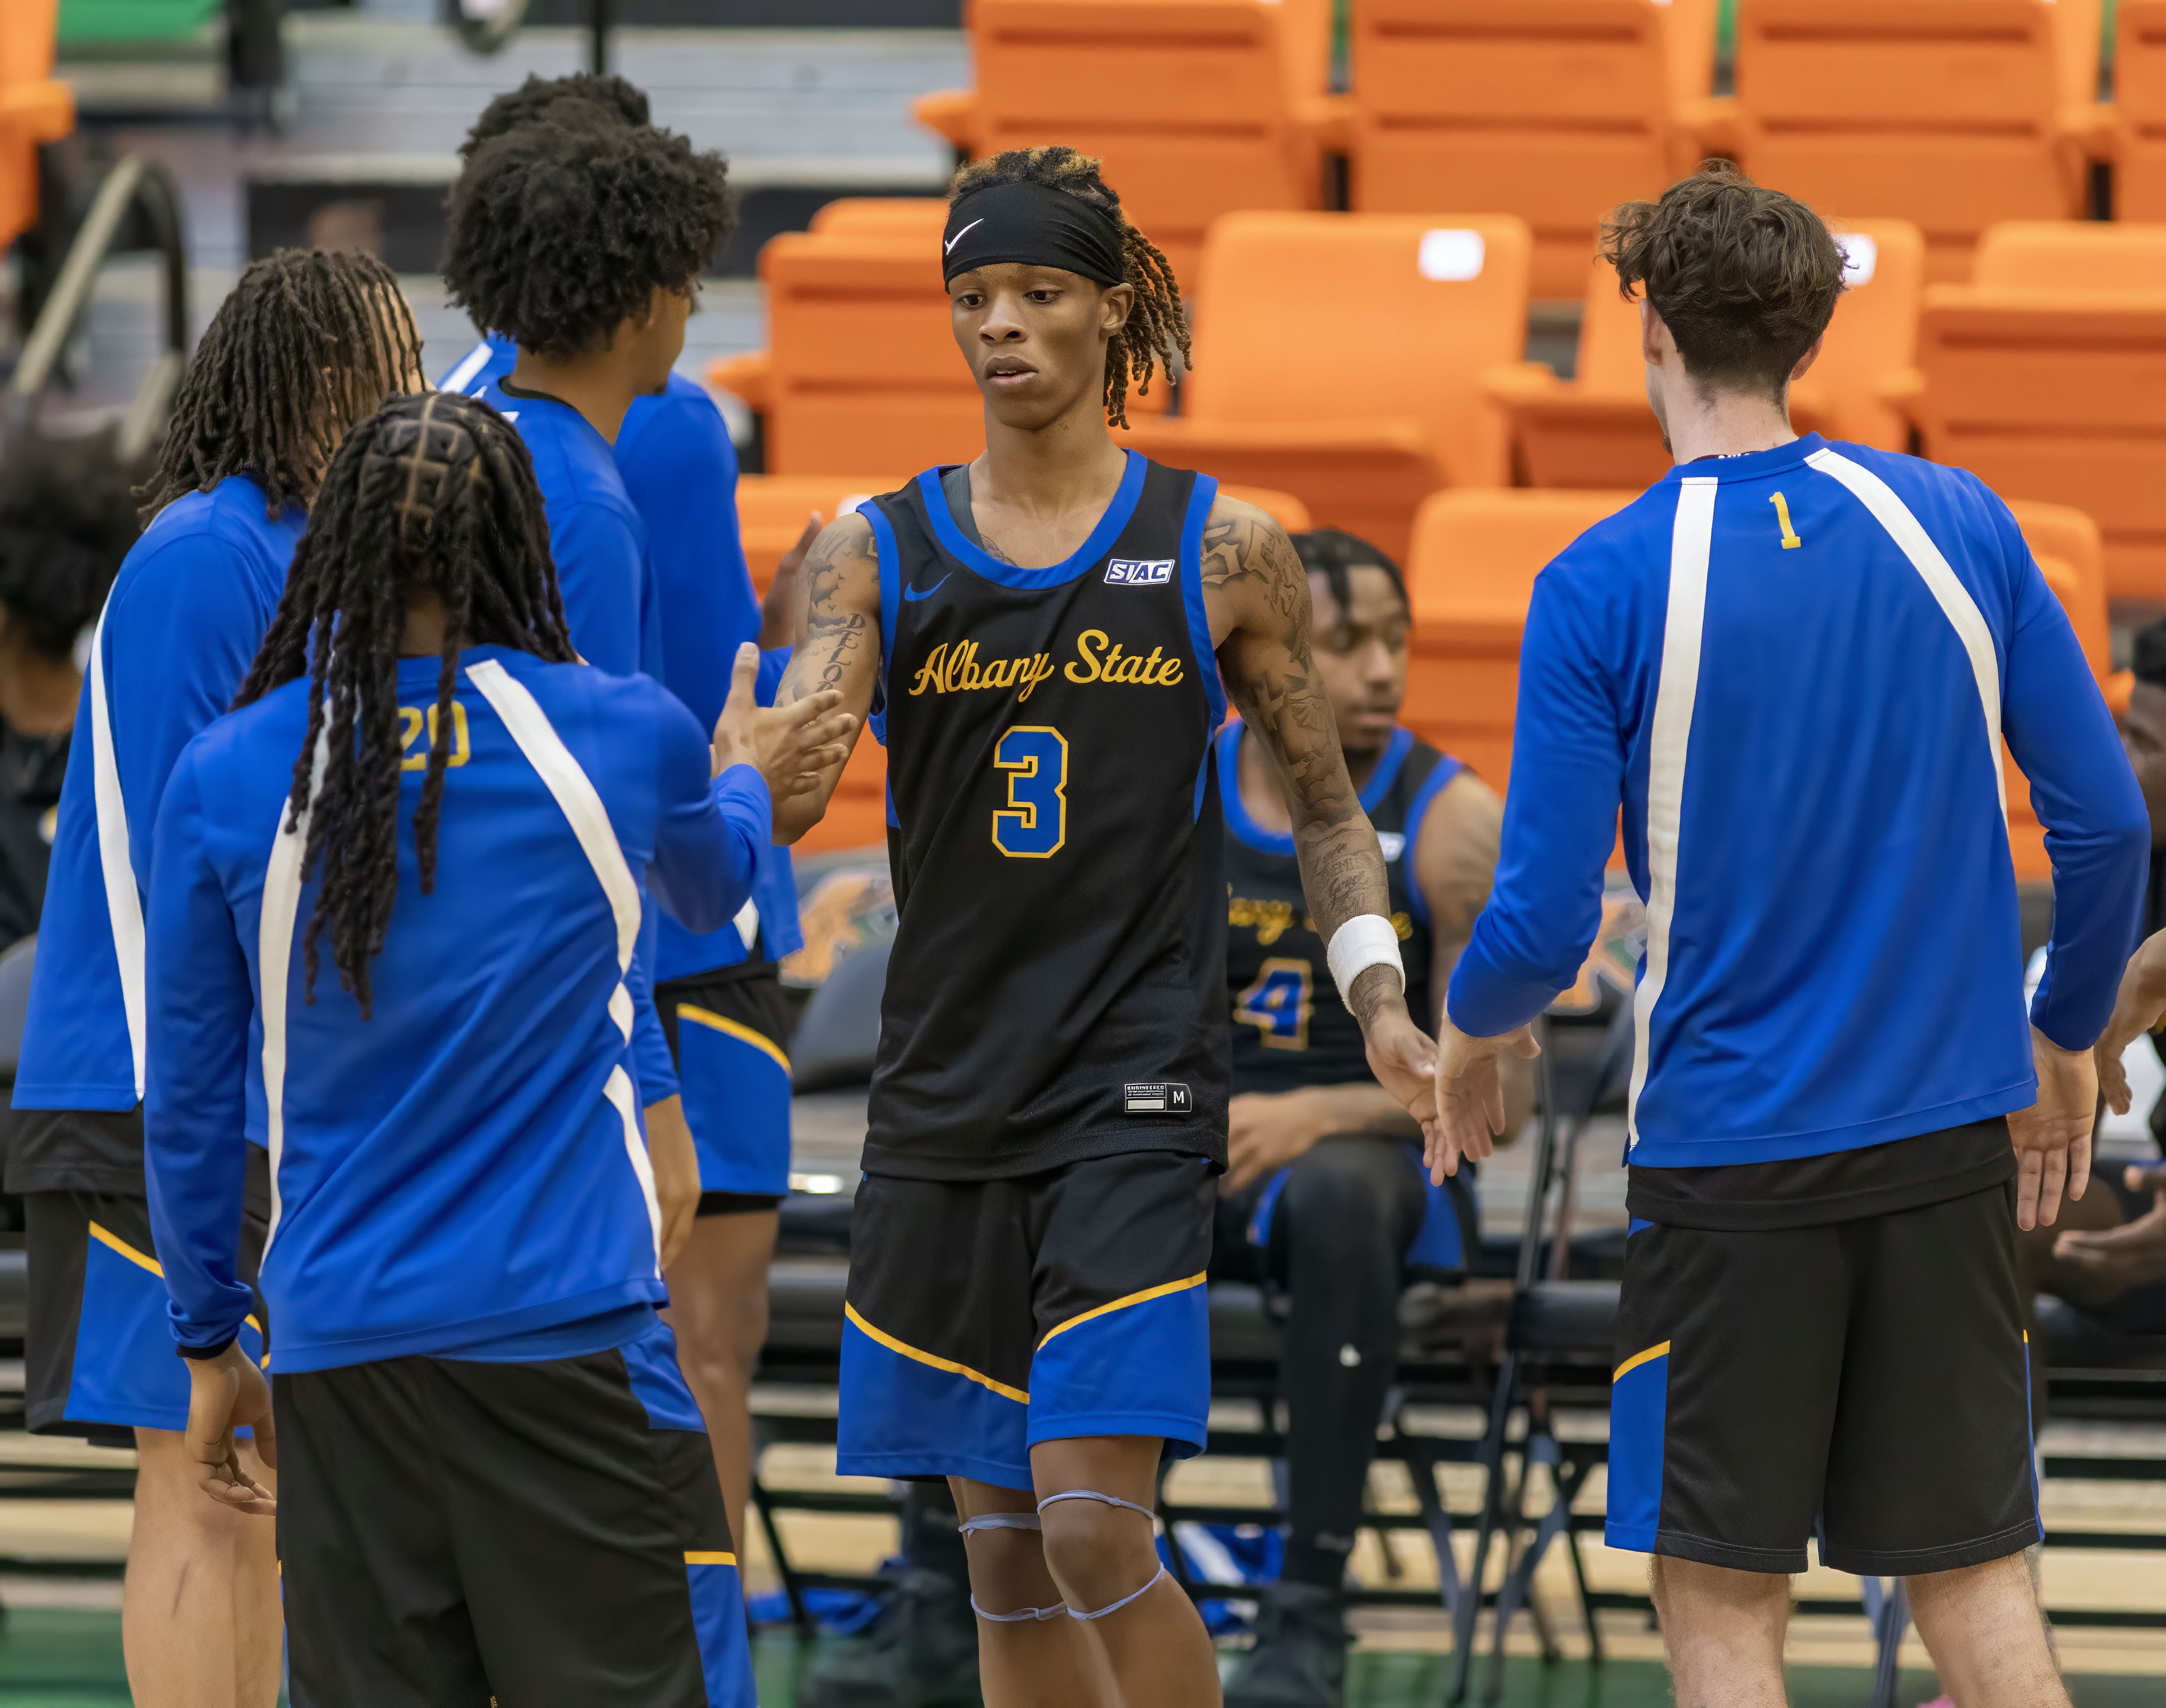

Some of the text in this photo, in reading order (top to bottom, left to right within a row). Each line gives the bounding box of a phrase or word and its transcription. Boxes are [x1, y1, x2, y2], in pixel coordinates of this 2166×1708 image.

[1769, 492, 1801, 549] 1
[1110, 563, 1169, 580] SIAC
[909, 629, 1183, 702] Albany State
[398, 700, 470, 771] 20
[992, 725, 1068, 858] 3
[1233, 957, 1314, 1051] 4
[1173, 1091, 1184, 1103] M
